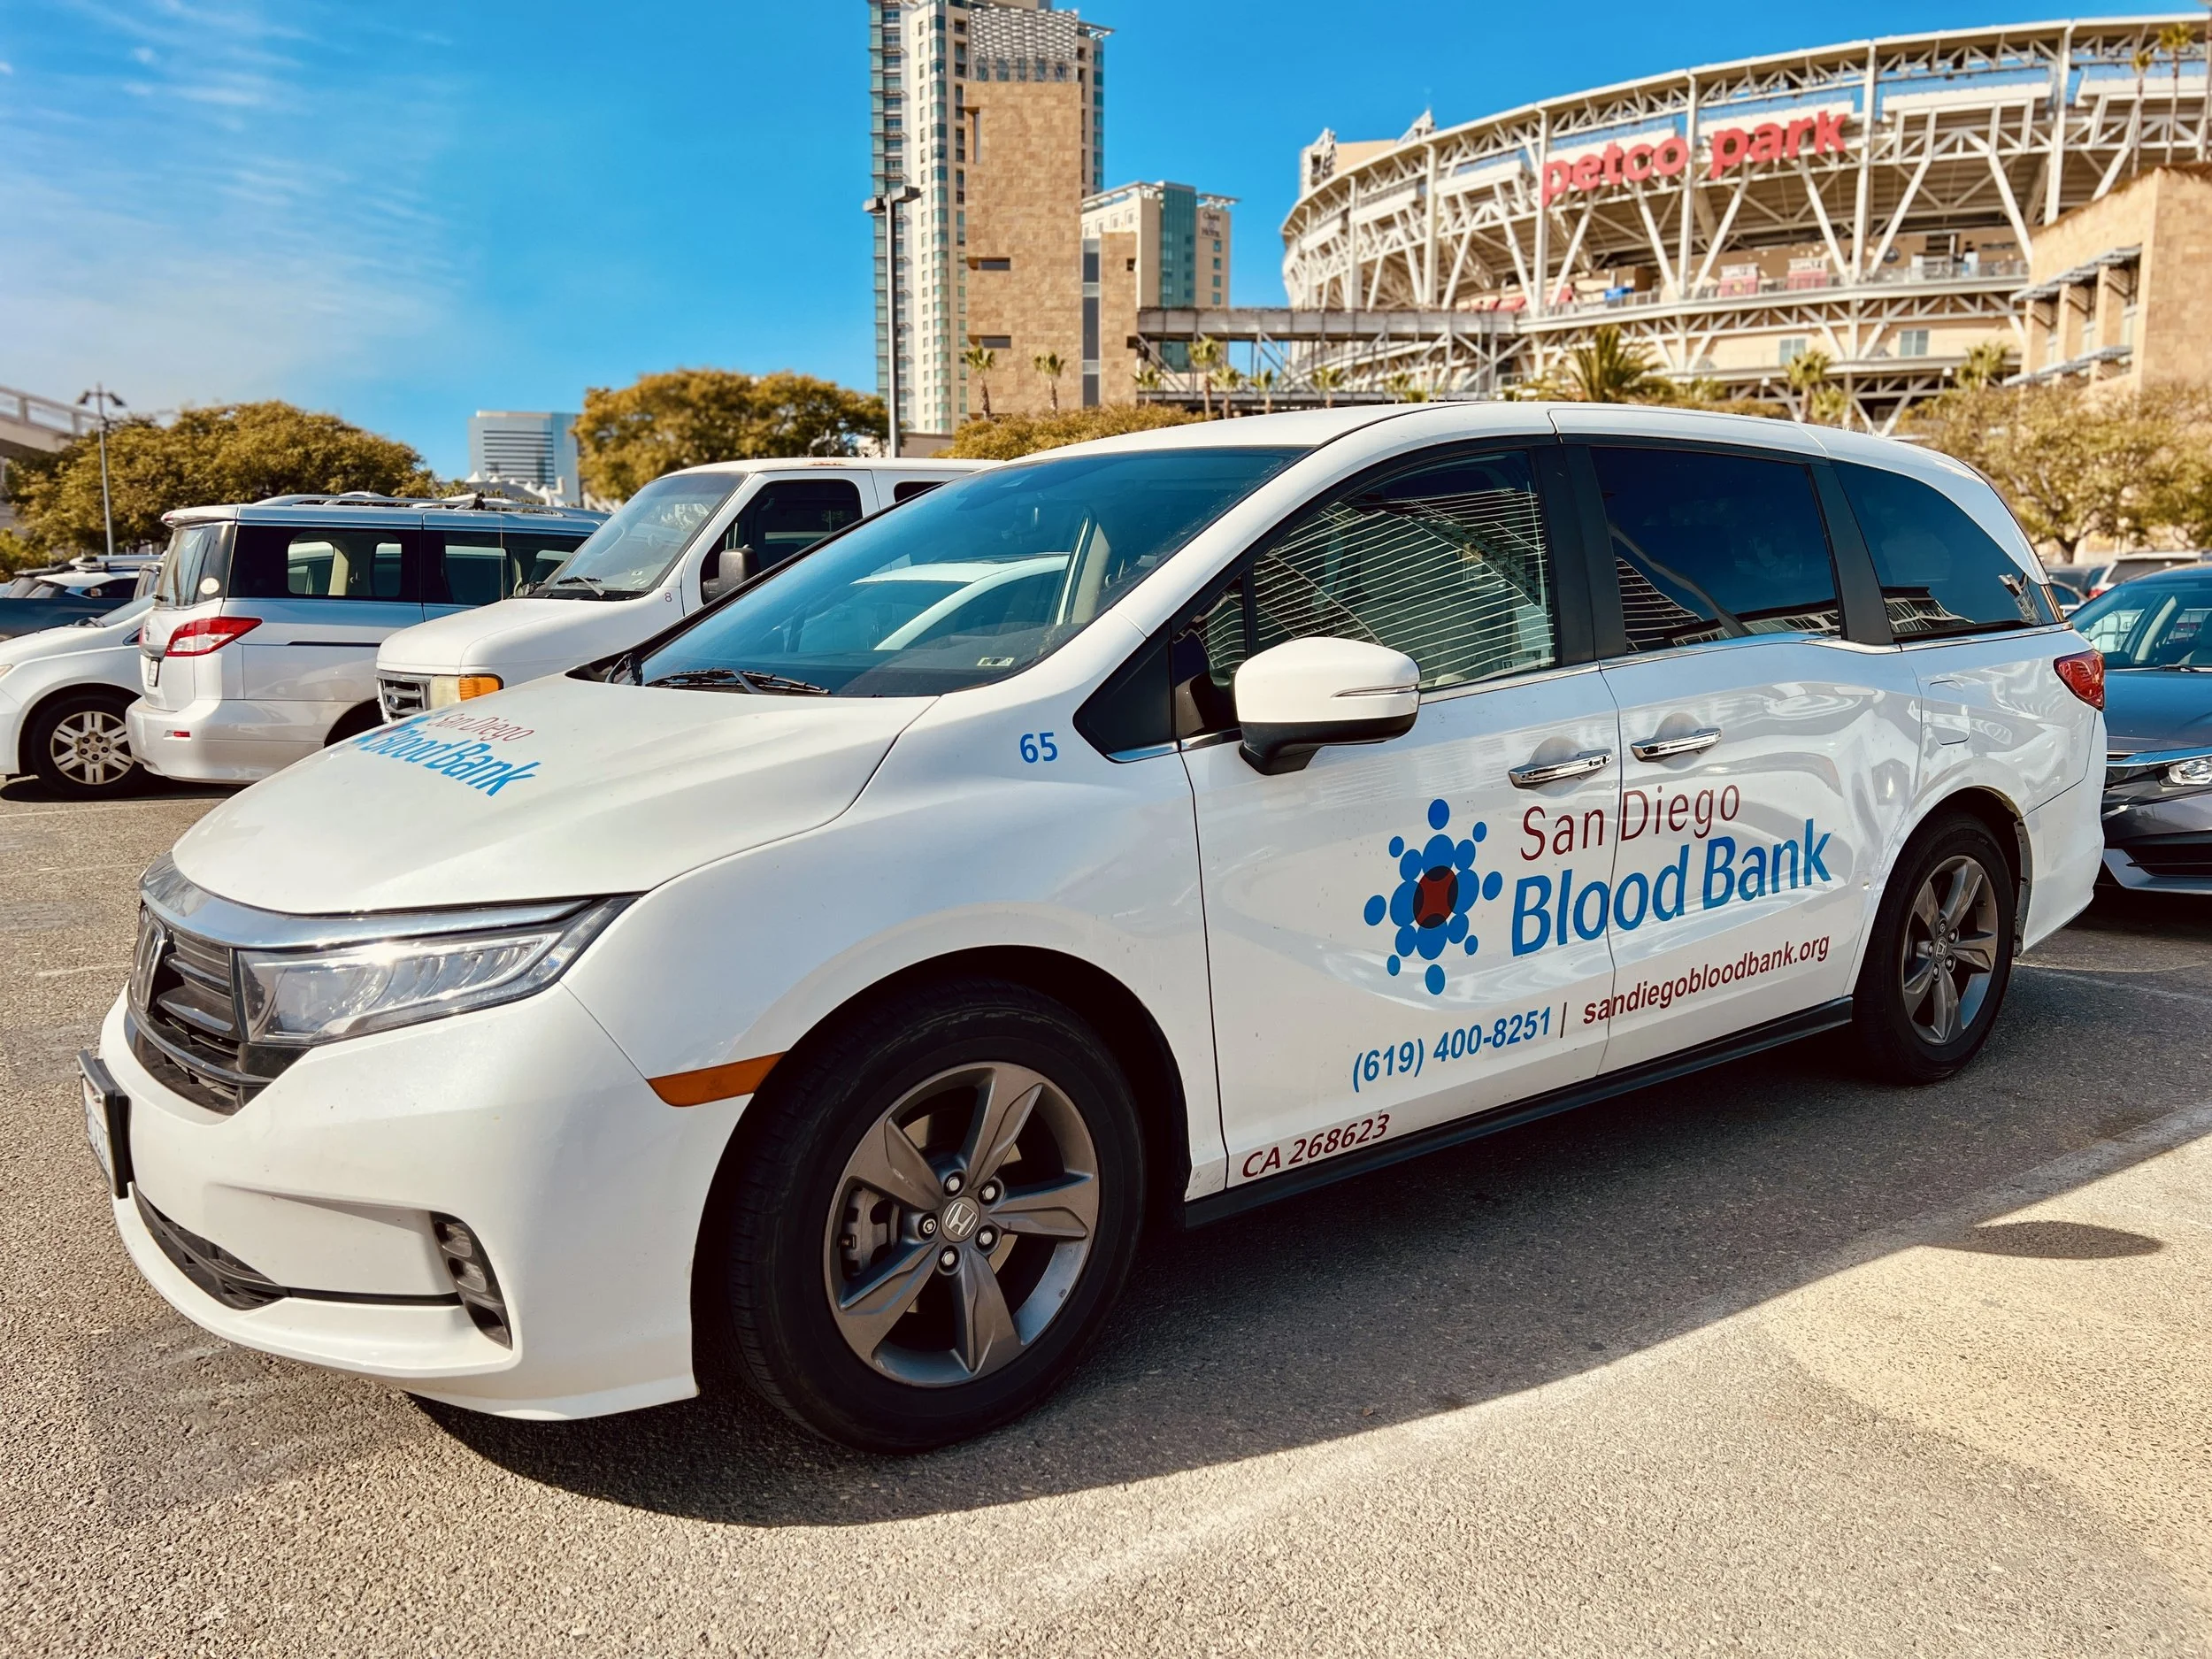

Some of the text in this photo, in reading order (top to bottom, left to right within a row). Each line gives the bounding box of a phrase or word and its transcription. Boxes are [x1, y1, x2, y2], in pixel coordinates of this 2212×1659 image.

[1542, 111, 1847, 206] petco park
[664, 592, 672, 603] 8
[426, 713, 534, 741] San Diego
[1019, 732, 1058, 764] 65
[359, 729, 541, 796] Blood Bank
[1520, 784, 1740, 861] San Diego
[1512, 818, 1832, 956] Blood Bank
[1352, 1038, 1425, 1092] (619)
[1433, 1005, 1552, 1064] 400-8251
[1583, 935, 1831, 1025] sandiegobloodbank.org
[1242, 1113, 1390, 1178] CA 268623
